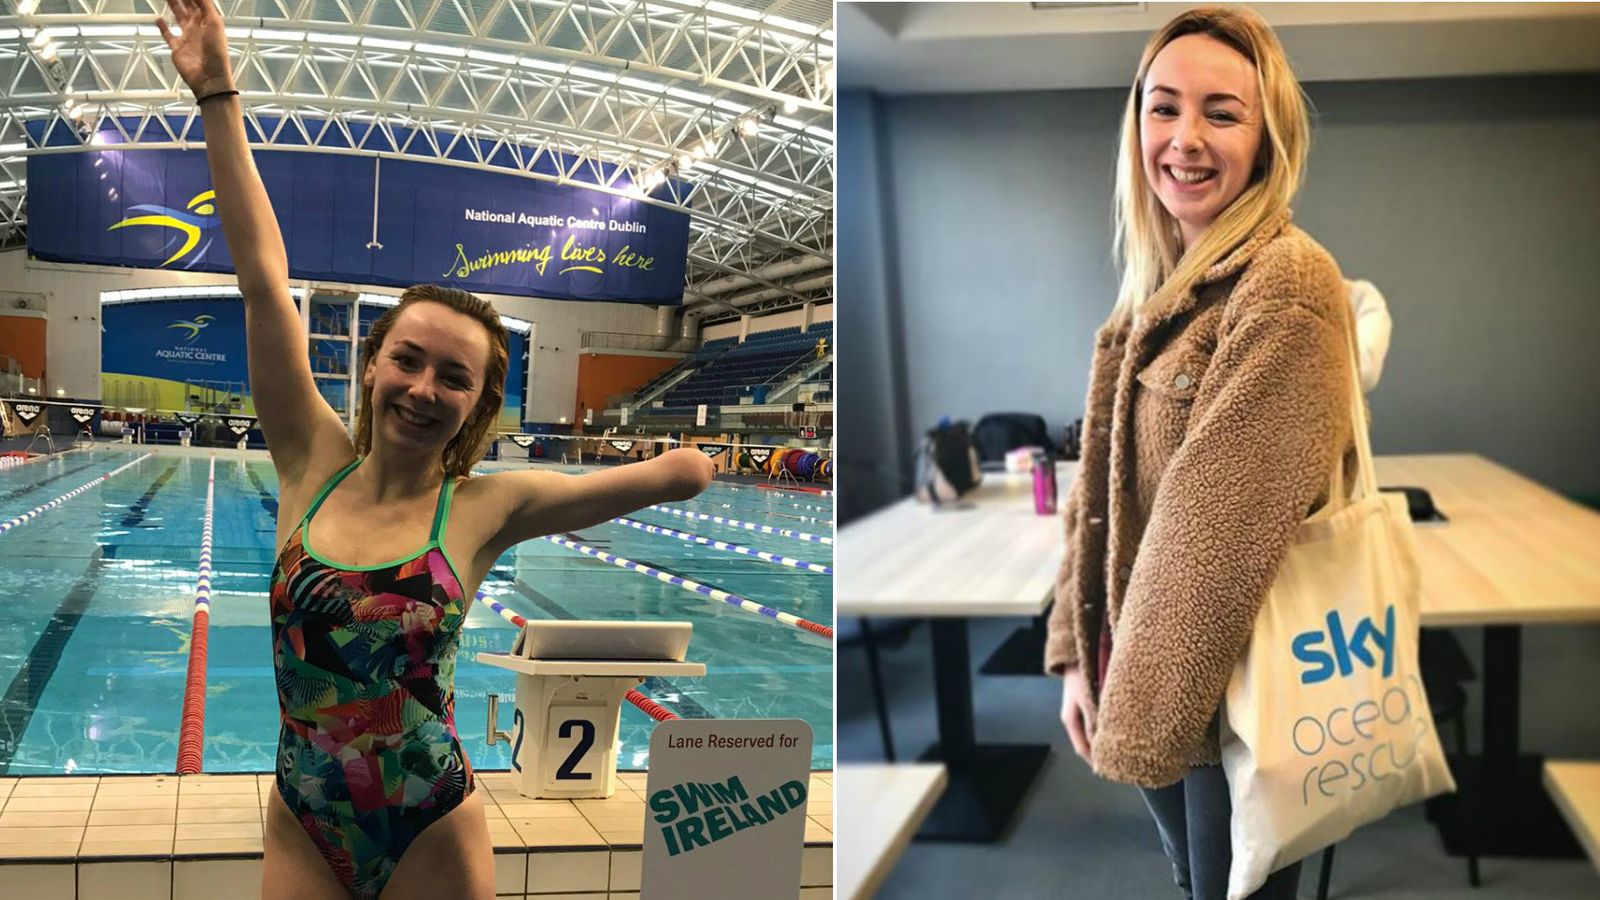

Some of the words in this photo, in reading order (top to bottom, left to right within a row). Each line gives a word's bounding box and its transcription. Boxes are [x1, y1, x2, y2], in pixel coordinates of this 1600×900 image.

[464, 208, 516, 224] National
[517, 212, 564, 228] Aquatic
[566, 215, 606, 231] Centre
[608, 219, 647, 234] Dublin
[442, 243, 554, 277] Swimming
[560, 234, 607, 264] lives
[612, 245, 655, 271] here
[155, 349, 194, 360] AQUATIC
[194, 351, 227, 362] CENTRE
[16, 404, 40, 413] arena
[70, 407, 95, 416] arena
[228, 419, 251, 428] arena
[1291, 604, 1396, 684] sky
[555, 719, 596, 780] 2
[668, 733, 703, 749] Lane
[708, 733, 775, 748] Reserved
[779, 733, 799, 748] for
[649, 775, 749, 824] SWIM
[661, 780, 808, 857] IRELAND
